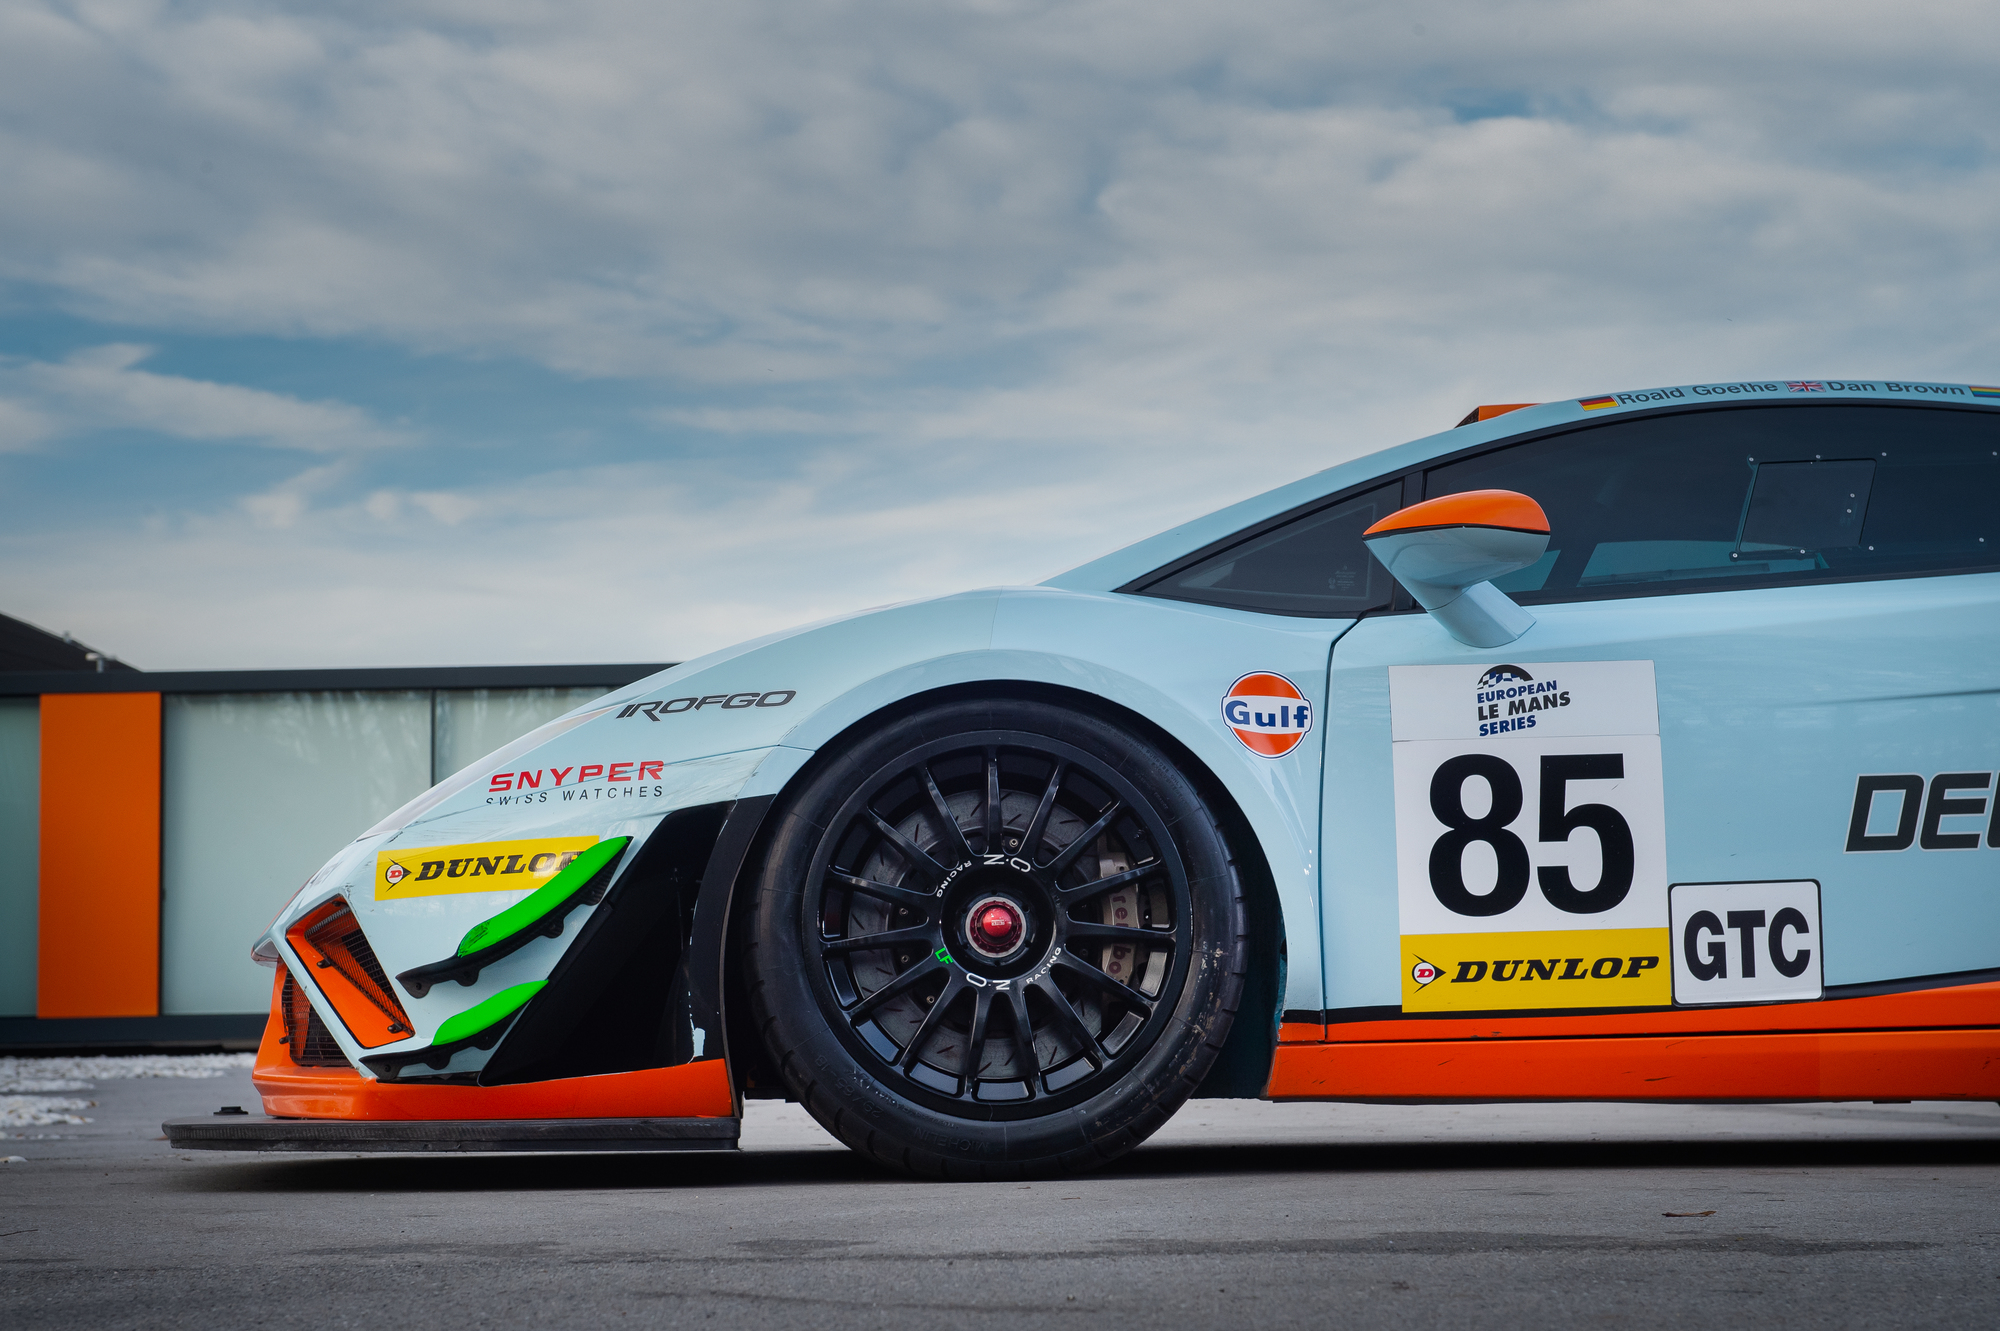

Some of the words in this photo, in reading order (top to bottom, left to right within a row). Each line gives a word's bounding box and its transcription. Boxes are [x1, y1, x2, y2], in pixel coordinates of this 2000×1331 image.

[1616, 387, 1685, 405] Roald
[1692, 380, 1778, 397] Goethe
[1827, 380, 1877, 393] Dan
[1884, 382, 1965, 396] Brown
[1477, 680, 1557, 703] EUROPEAN
[1225, 700, 1309, 728] Gulf
[1478, 702, 1499, 721] LE
[1508, 691, 1571, 716] MANS
[1479, 715, 1537, 736] SERIES
[488, 760, 664, 793] SNYPER
[562, 785, 663, 802] WATCHES
[1844, 771, 2000, 853] DE
[1428, 753, 1637, 916] 85
[936, 860, 973, 898] RACING
[935, 947, 954, 965] LF
[1683, 907, 1811, 981] GTC
[1025, 946, 1062, 984] RACING
[1450, 956, 1660, 984] DUNLOP
[912, 1125, 990, 1152] MICHELIN
